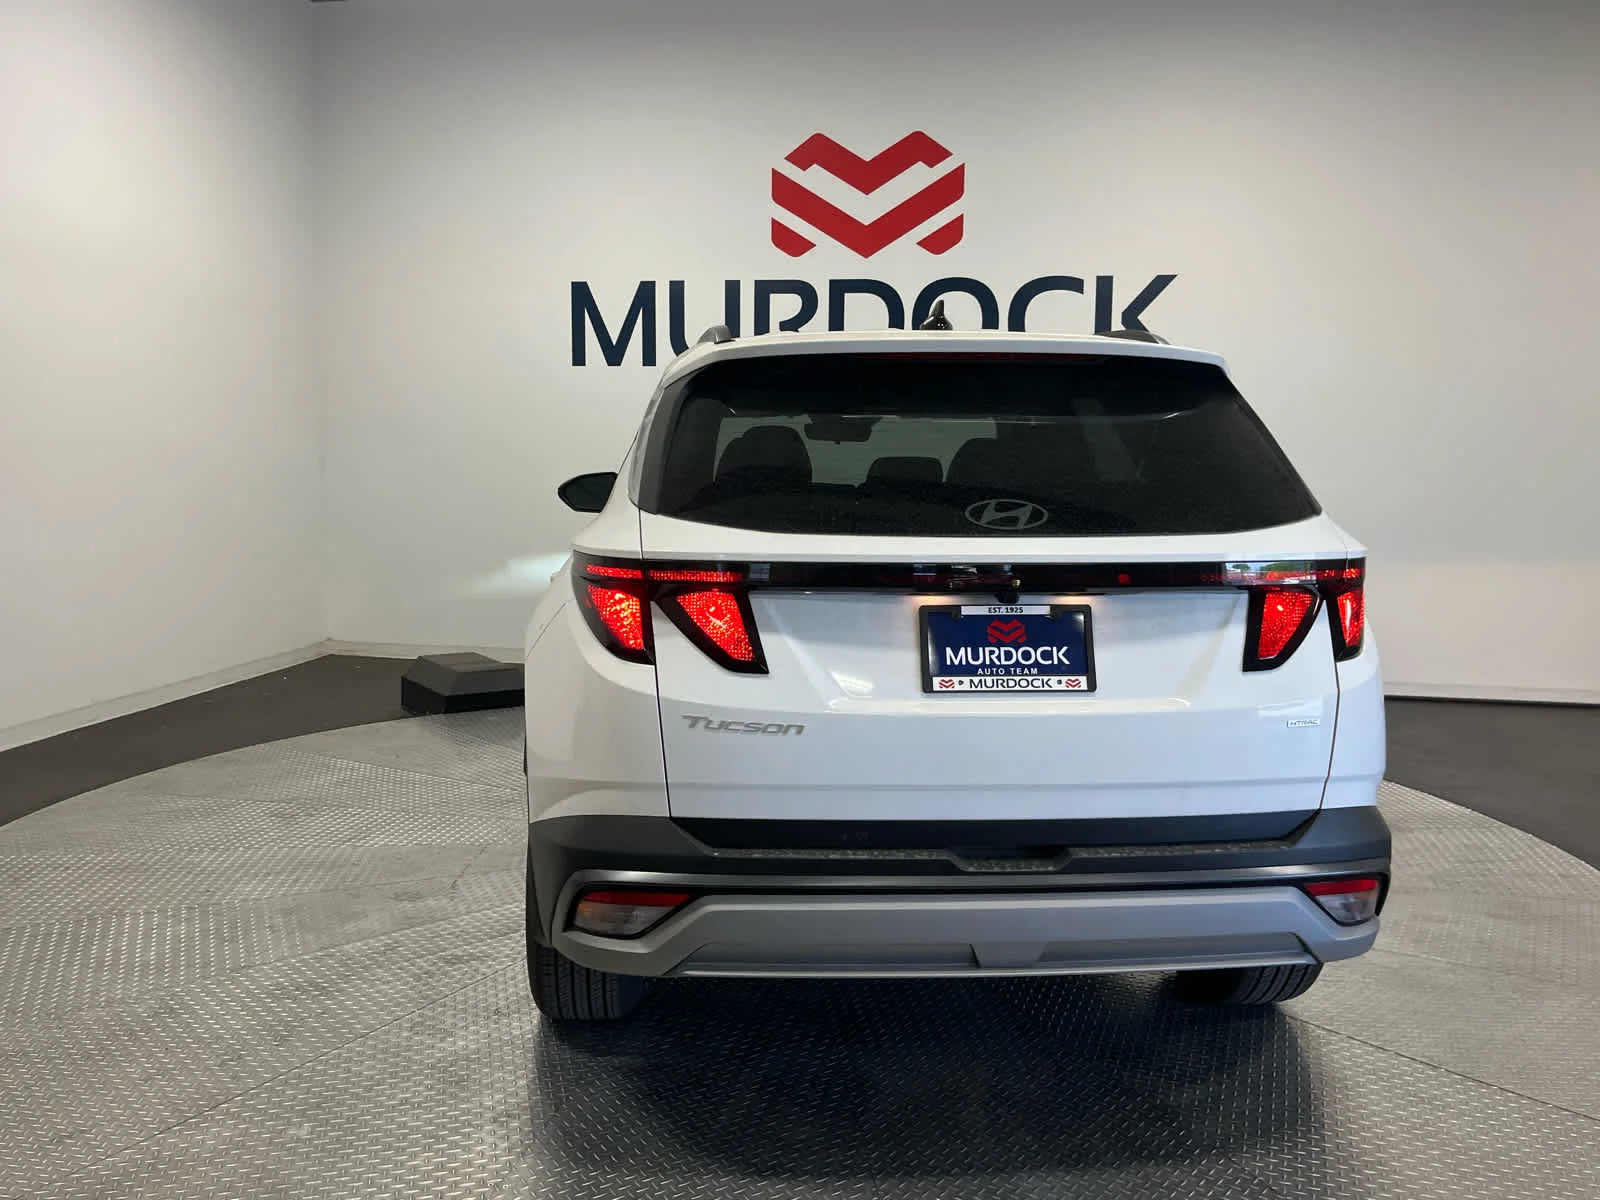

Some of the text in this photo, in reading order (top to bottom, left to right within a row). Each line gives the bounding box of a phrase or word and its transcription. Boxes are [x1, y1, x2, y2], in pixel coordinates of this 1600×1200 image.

[571, 274, 1178, 367] MURDOCK
[988, 606, 1024, 614] EST. 1925
[945, 646, 1070, 666] MURDOCK
[977, 667, 1038, 675] AUTO TEAM
[969, 678, 1053, 689] MURDOCK
